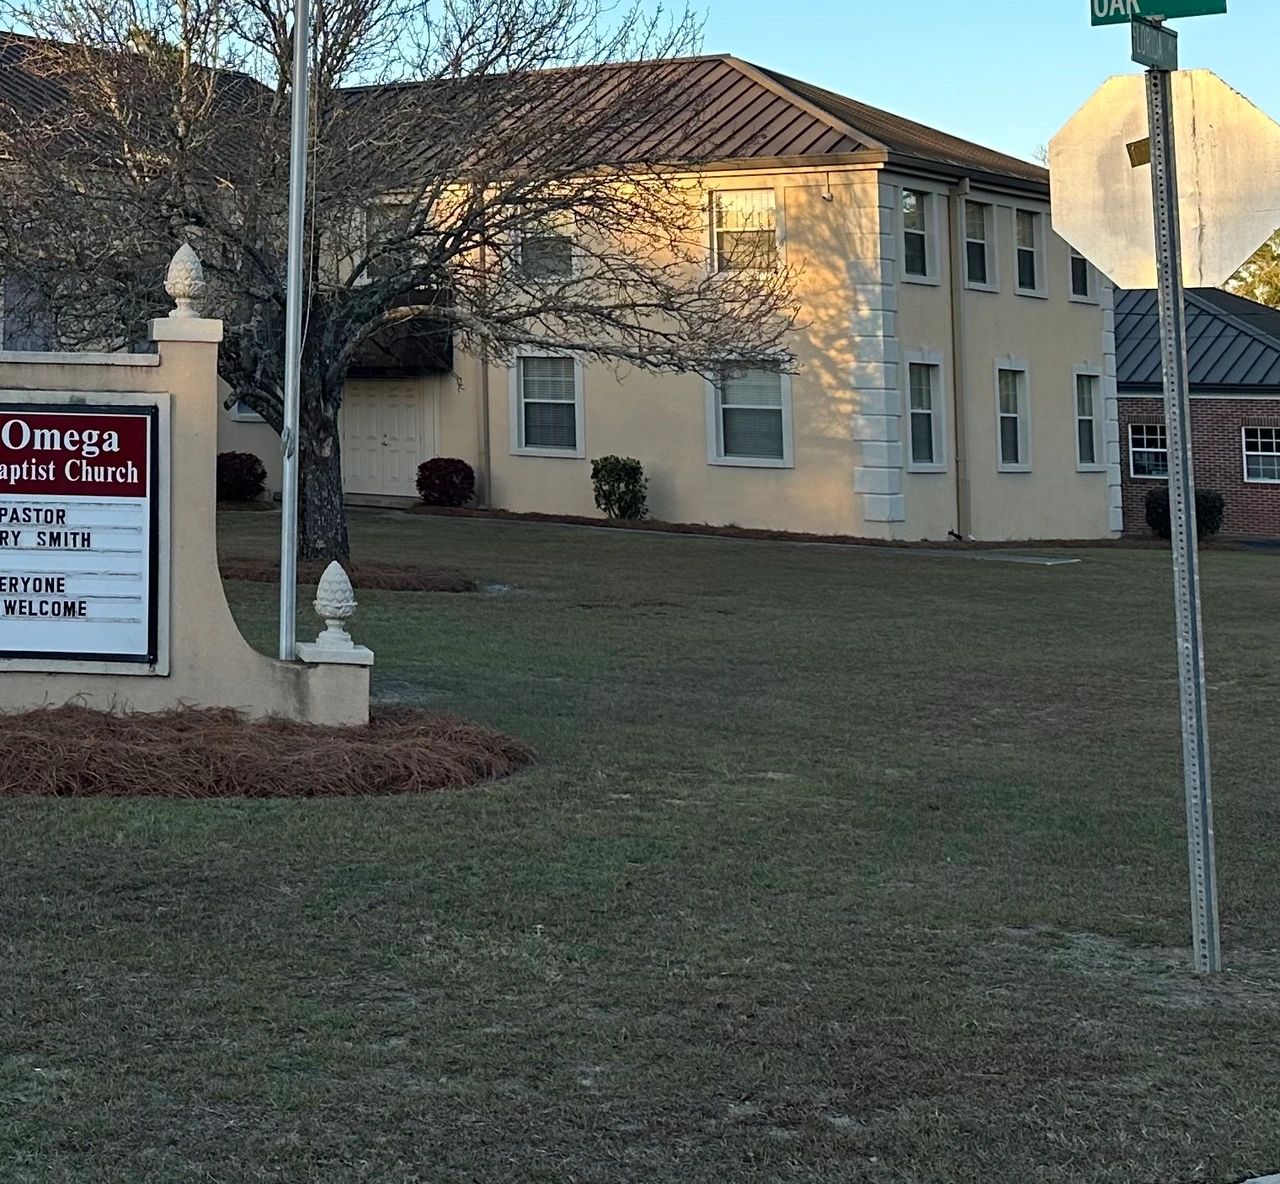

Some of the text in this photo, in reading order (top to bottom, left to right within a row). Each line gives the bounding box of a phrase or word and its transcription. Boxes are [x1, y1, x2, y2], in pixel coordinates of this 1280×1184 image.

[1, 419, 120, 458] Omega
[64, 459, 139, 484] Church
[37, 531, 91, 548] SMITH
[4, 600, 87, 617] WELCOME
